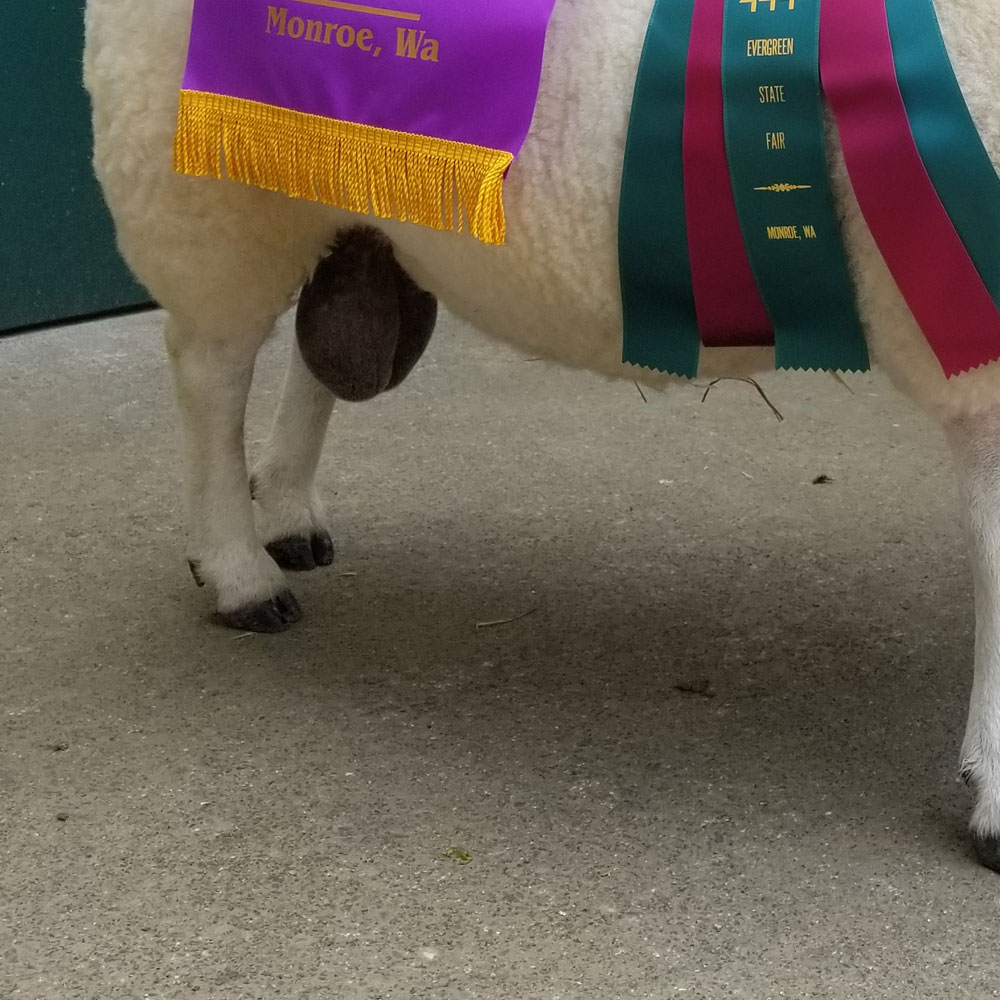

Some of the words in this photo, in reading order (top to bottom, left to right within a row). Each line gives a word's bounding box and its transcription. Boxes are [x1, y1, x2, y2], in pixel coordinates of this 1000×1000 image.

[265, 6, 382, 58] Monroe,
[395, 27, 440, 62] Wa
[747, 38, 794, 57] EVERGREEN
[759, 85, 786, 103] STATE
[766, 132, 786, 150] FAIR
[767, 226, 801, 240] MONROE,
[803, 226, 816, 239] WA
